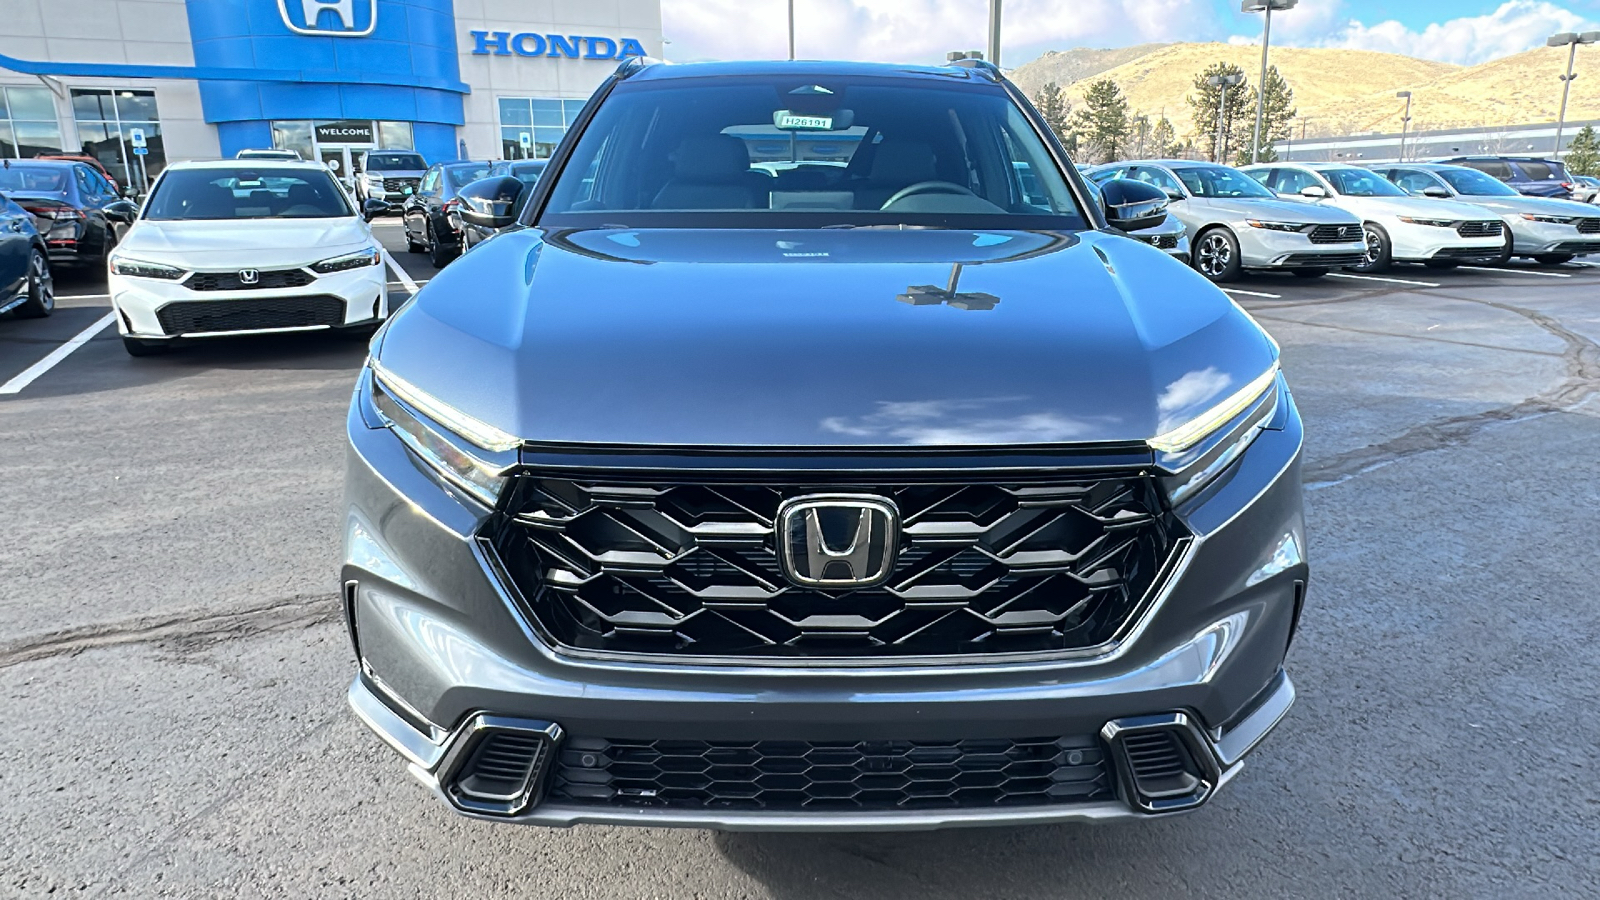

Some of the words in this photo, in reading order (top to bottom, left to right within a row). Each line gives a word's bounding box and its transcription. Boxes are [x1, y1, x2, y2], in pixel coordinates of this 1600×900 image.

[470, 31, 647, 60] HONDA
[786, 118, 826, 127] H26191
[319, 128, 370, 136] WELCOME
